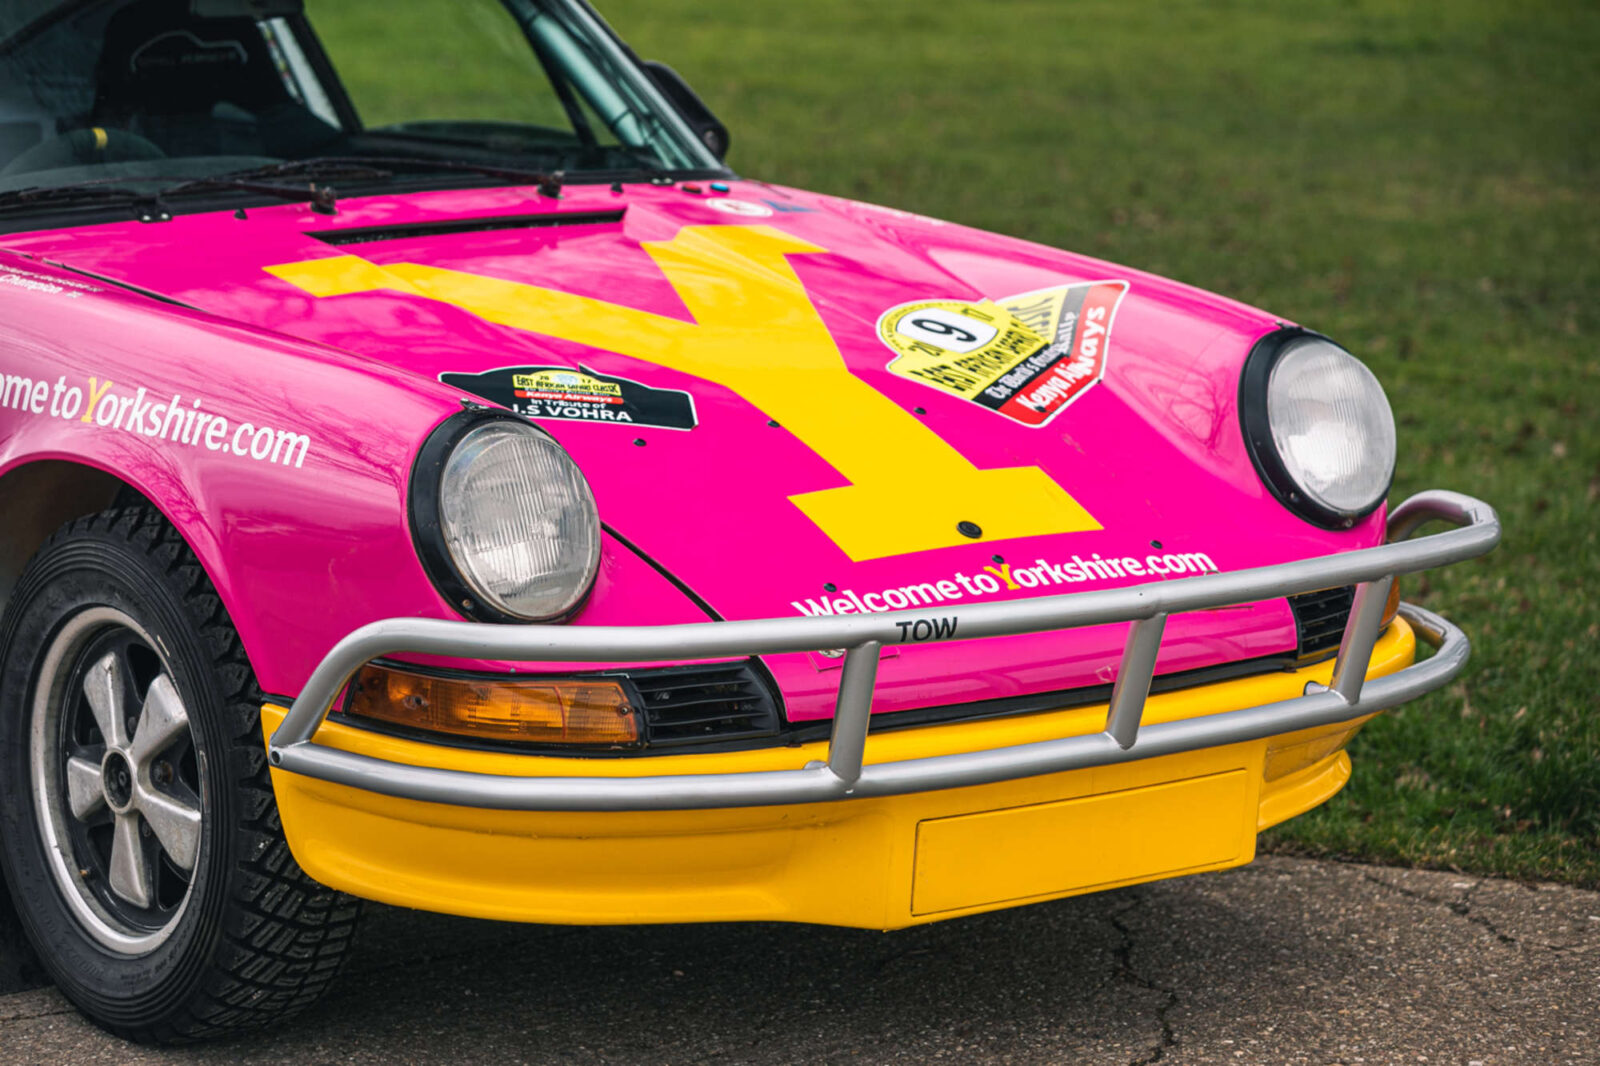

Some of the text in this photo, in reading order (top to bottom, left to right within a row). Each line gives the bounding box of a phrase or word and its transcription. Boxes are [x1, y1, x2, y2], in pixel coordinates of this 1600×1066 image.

[911, 318, 977, 343] 9
[525, 391, 562, 400] Kenya
[564, 393, 613, 403] Airways
[544, 399, 590, 409] Tribute
[592, 402, 606, 410] of
[1015, 376, 1072, 412] Kenya
[545, 405, 633, 422] VOHRA
[895, 616, 958, 643] TOW
